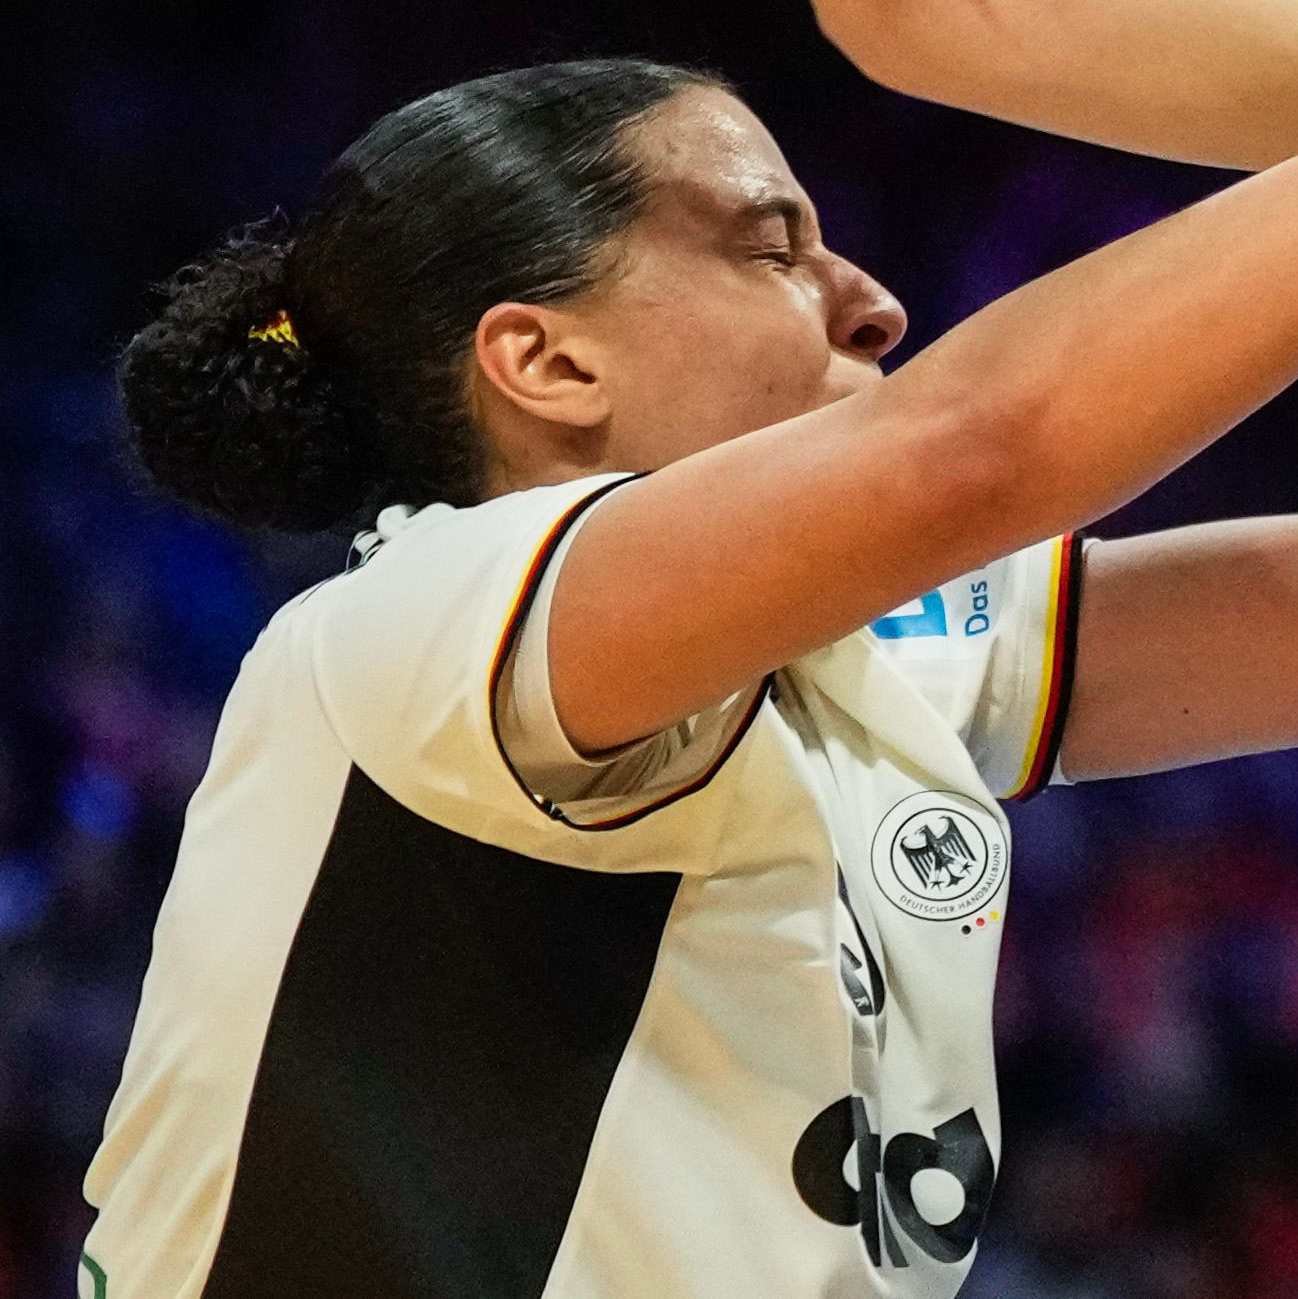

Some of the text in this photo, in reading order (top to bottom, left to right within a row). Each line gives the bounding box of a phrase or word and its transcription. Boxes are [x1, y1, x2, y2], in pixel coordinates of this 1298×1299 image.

[964, 579, 990, 637] Das
[900, 844, 1001, 914] DEUTSCHER HANDBALLBUND
